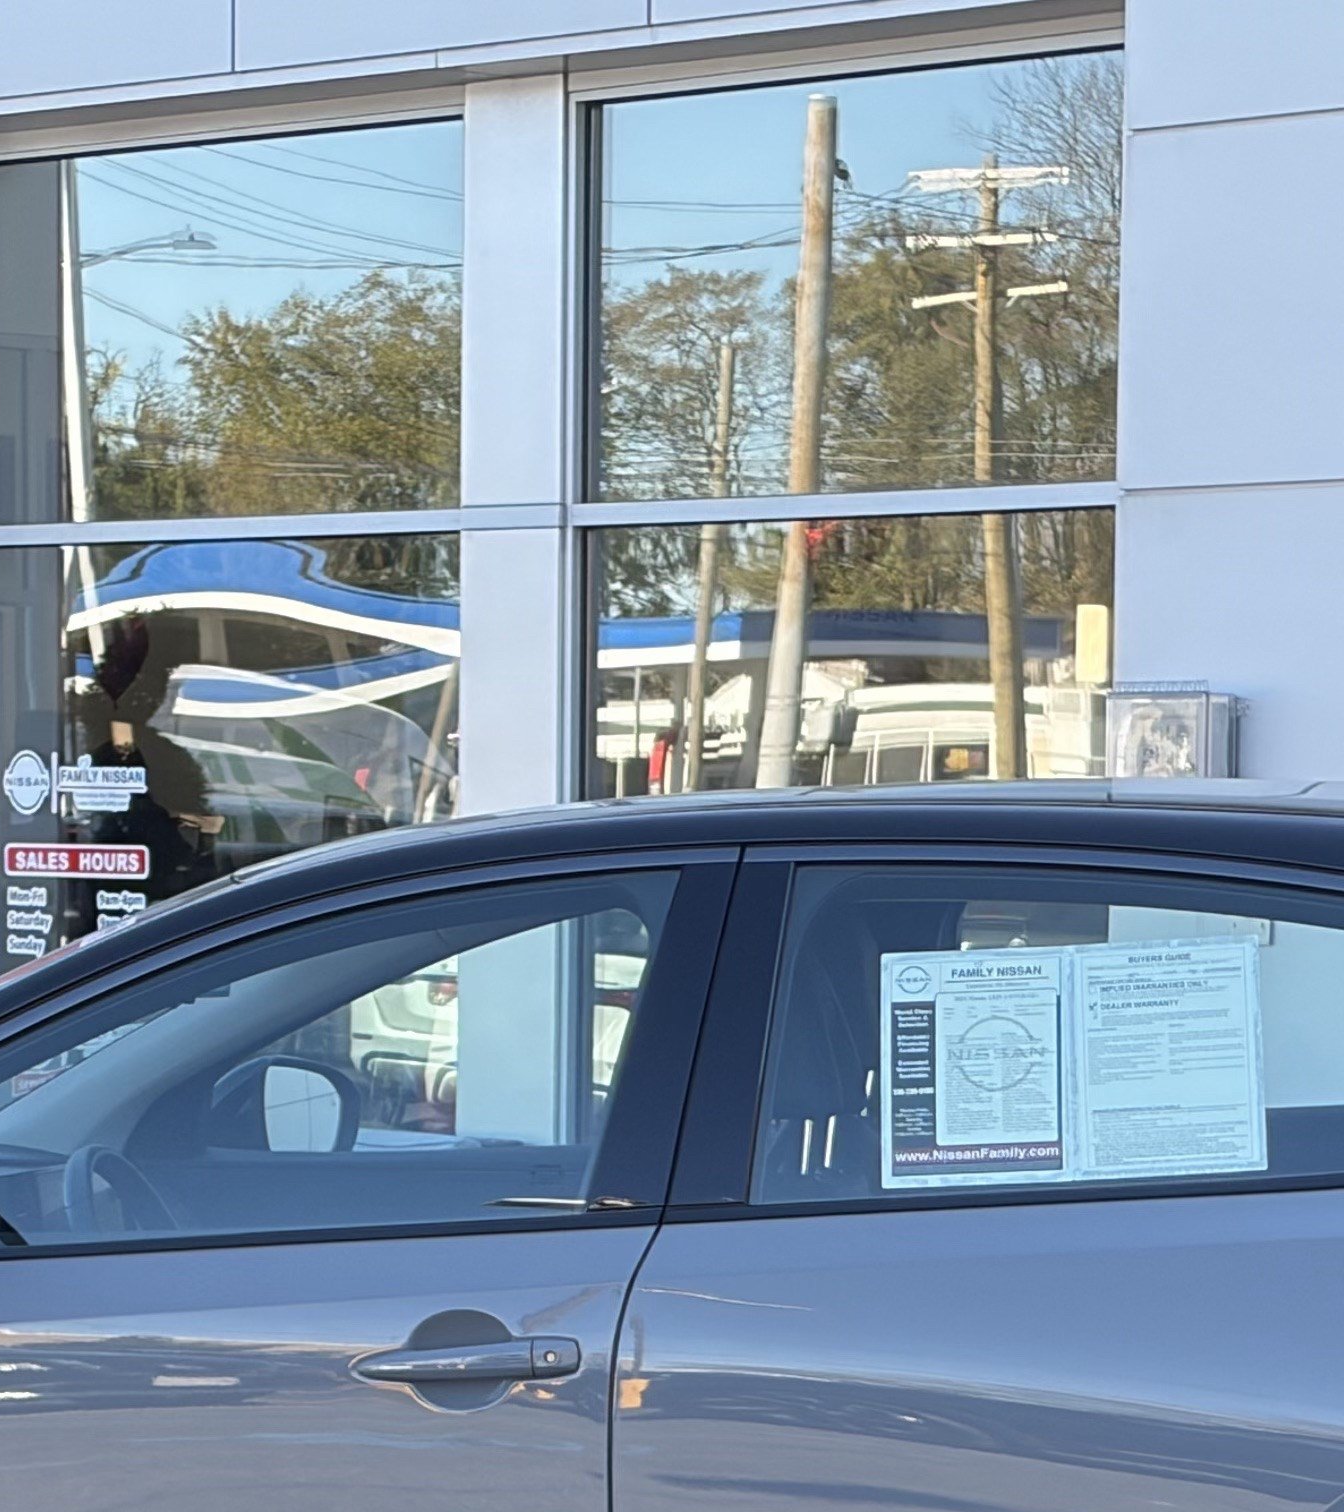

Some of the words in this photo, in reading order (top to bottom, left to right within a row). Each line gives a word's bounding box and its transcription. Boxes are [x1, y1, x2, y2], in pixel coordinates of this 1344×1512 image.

[6, 777, 49, 787] NISSAN
[60, 769, 98, 783] FAMILY
[101, 770, 144, 785] NISSAN
[15, 851, 70, 871] SALES
[78, 852, 140, 873] HOURS
[8, 913, 50, 930] Saturday
[8, 937, 43, 954] Sunday
[1128, 954, 1163, 963] BUYERS
[950, 966, 994, 979] FAMILY
[996, 965, 1042, 977] NISSAN
[1100, 1001, 1132, 1010] DEALER
[1134, 999, 1179, 1009] WARRANTY
[946, 1046, 1047, 1061] NISSAN
[894, 1146, 1059, 1163] www.NissanFamily.com
